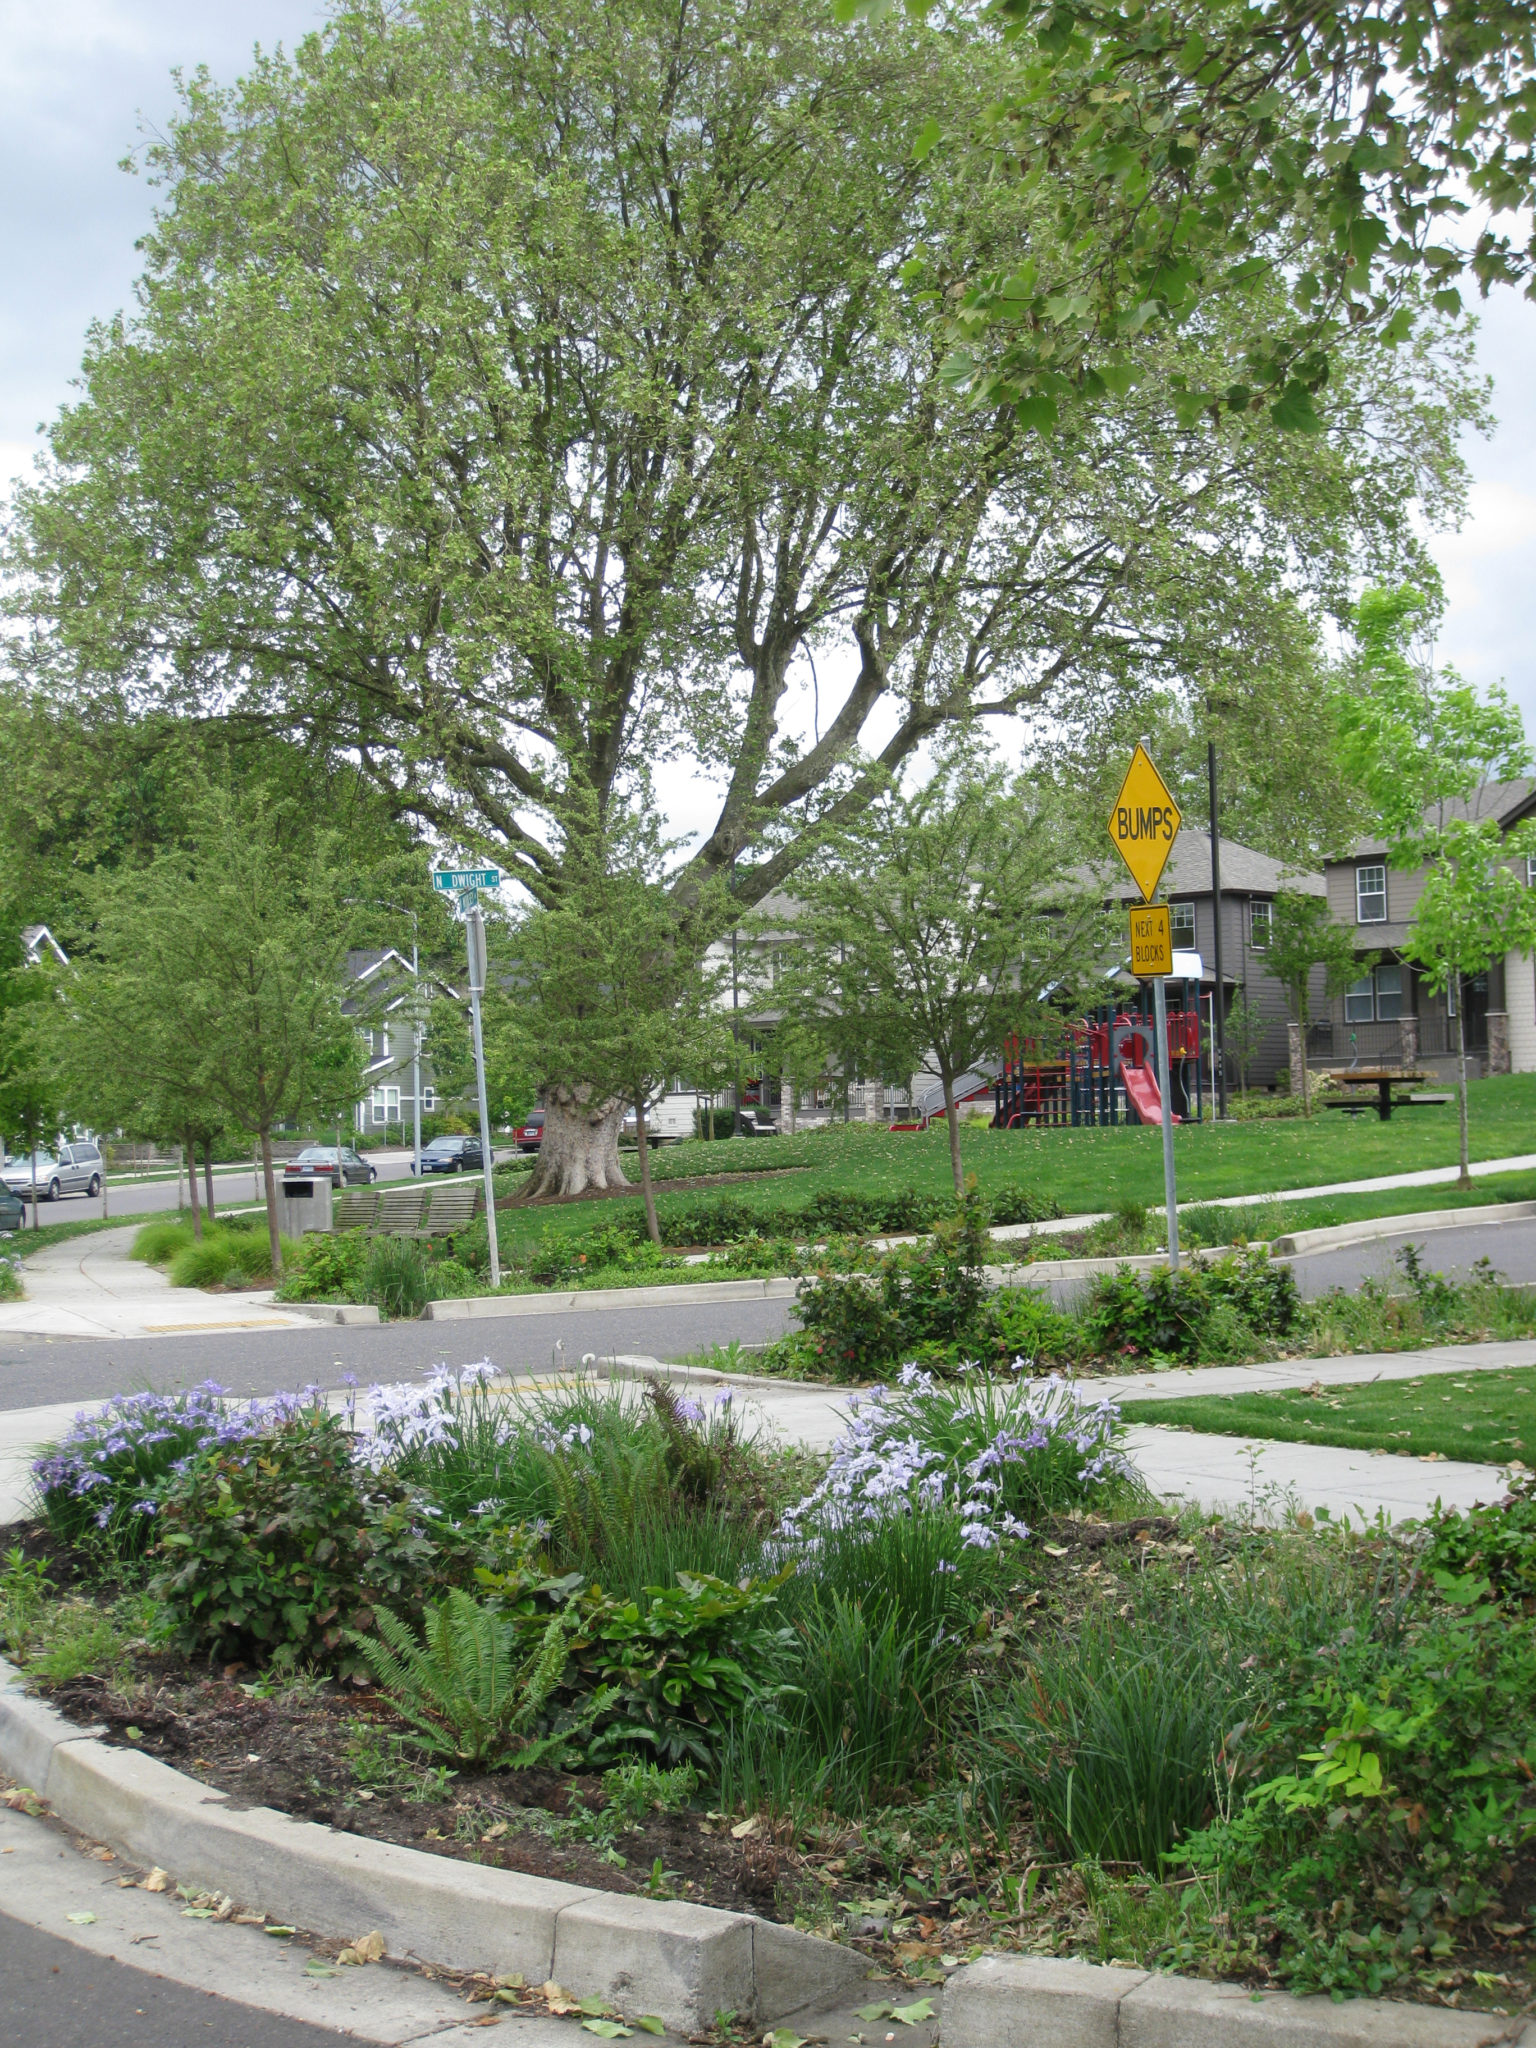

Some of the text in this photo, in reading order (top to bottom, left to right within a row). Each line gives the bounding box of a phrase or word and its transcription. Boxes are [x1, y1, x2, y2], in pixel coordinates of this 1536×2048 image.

[1117, 807, 1173, 841] BUMPS
[435, 872, 498, 888] N DWIGHT ST
[1135, 919, 1164, 938] NEXT 4
[1135, 945, 1164, 962] BLOCKS
